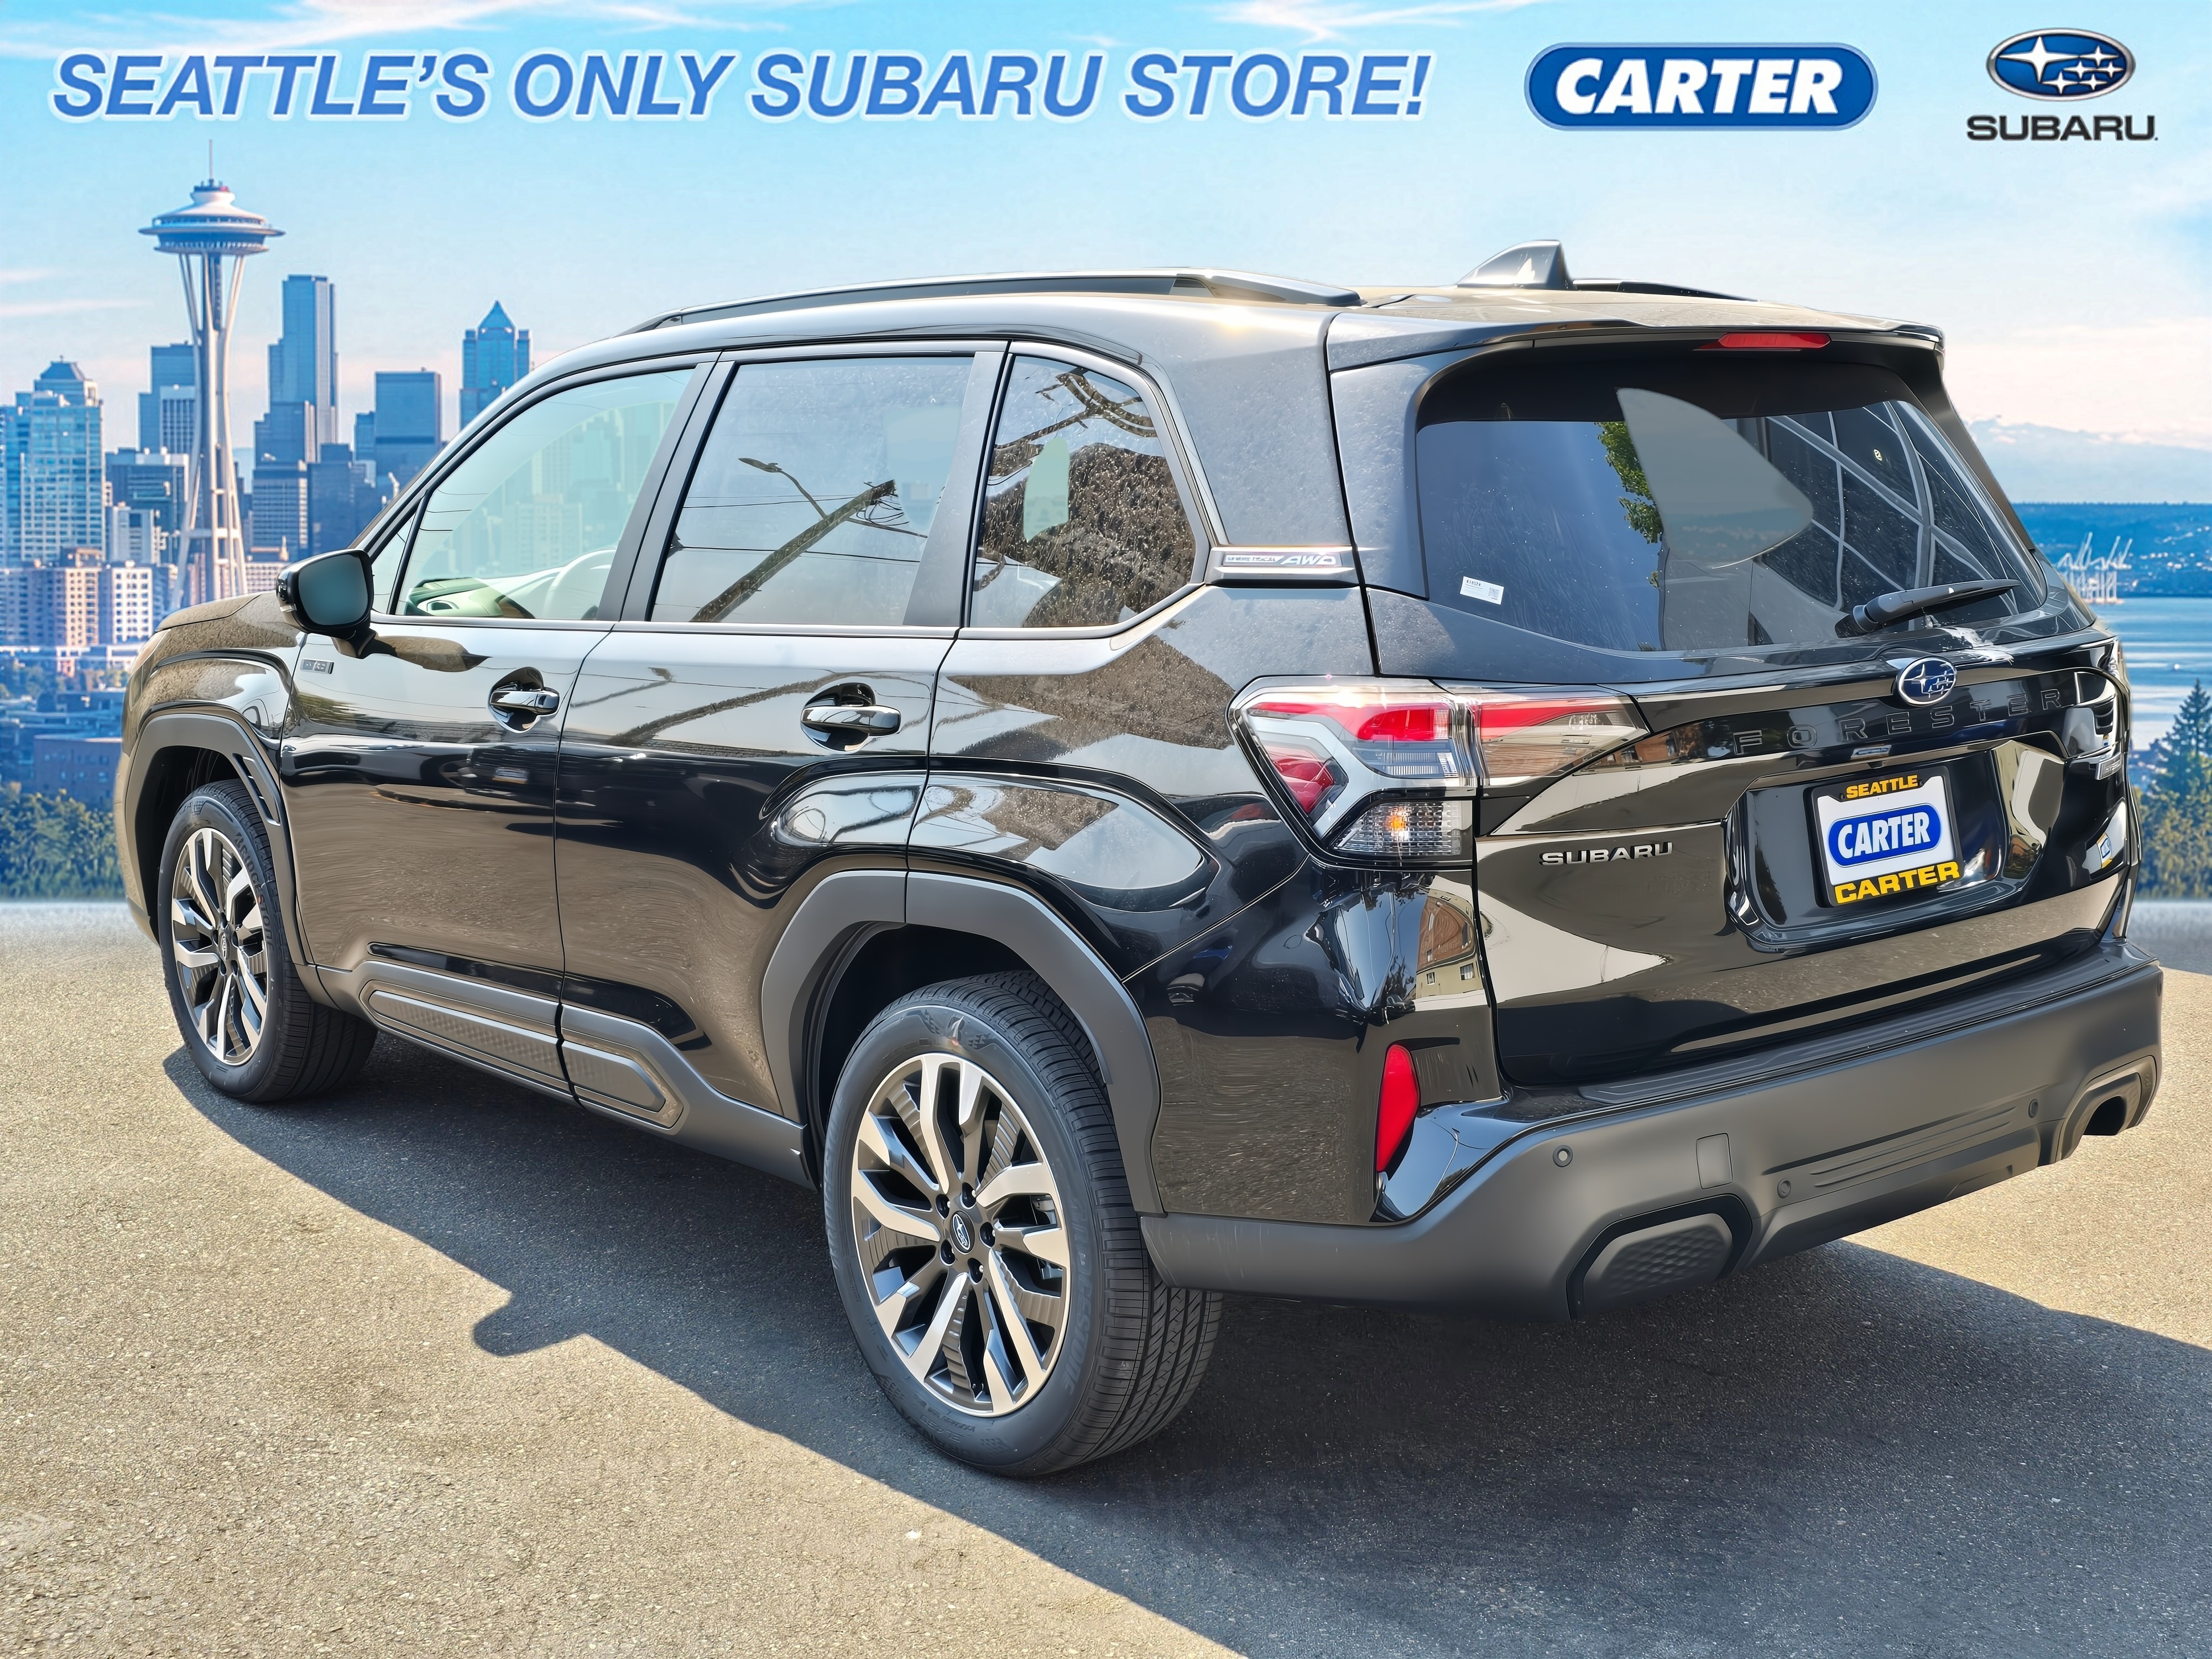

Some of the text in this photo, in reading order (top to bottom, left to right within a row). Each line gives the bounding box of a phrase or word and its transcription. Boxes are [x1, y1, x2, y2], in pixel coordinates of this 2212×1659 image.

[1733, 688, 2062, 755] FORESTER
[1846, 775, 1918, 799] SEATTLE
[1540, 842, 1673, 866] SUBARU
[1838, 811, 1931, 859] CARTER
[1834, 861, 1960, 904] CARTER
